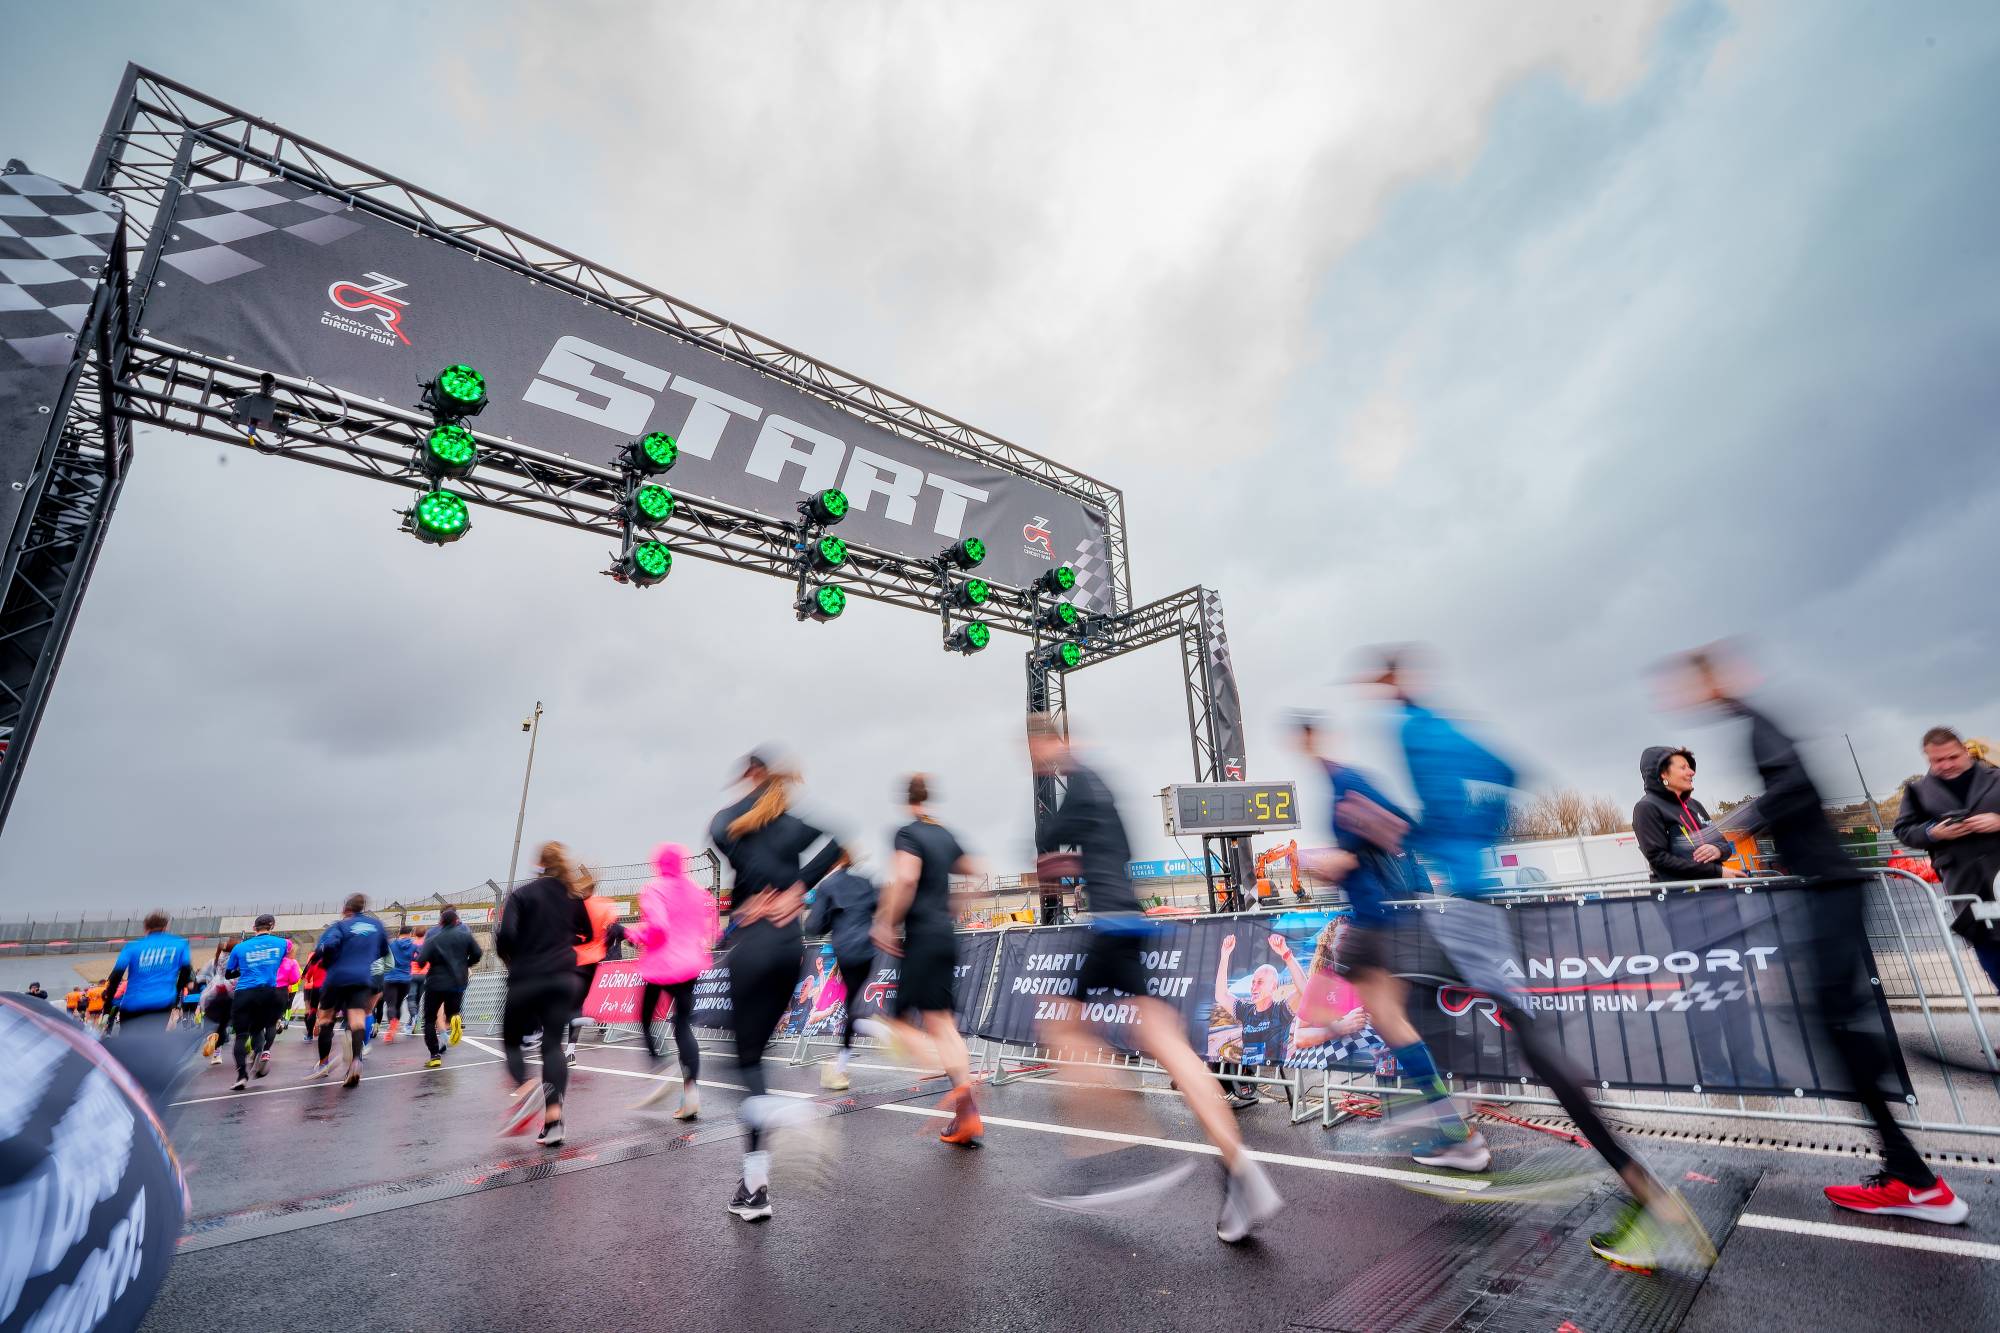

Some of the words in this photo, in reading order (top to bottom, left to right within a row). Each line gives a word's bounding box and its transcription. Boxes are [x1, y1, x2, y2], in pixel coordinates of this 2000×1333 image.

[320, 316, 368, 338] CIRCUIT
[370, 333, 395, 346] RUN
[322, 310, 398, 338] ZANDVOORT
[521, 335, 989, 540] START
[1027, 953, 1073, 971] START
[599, 970, 631, 988] BJÖRN
[697, 969, 722, 981] START
[1593, 995, 1638, 1012] RUN
